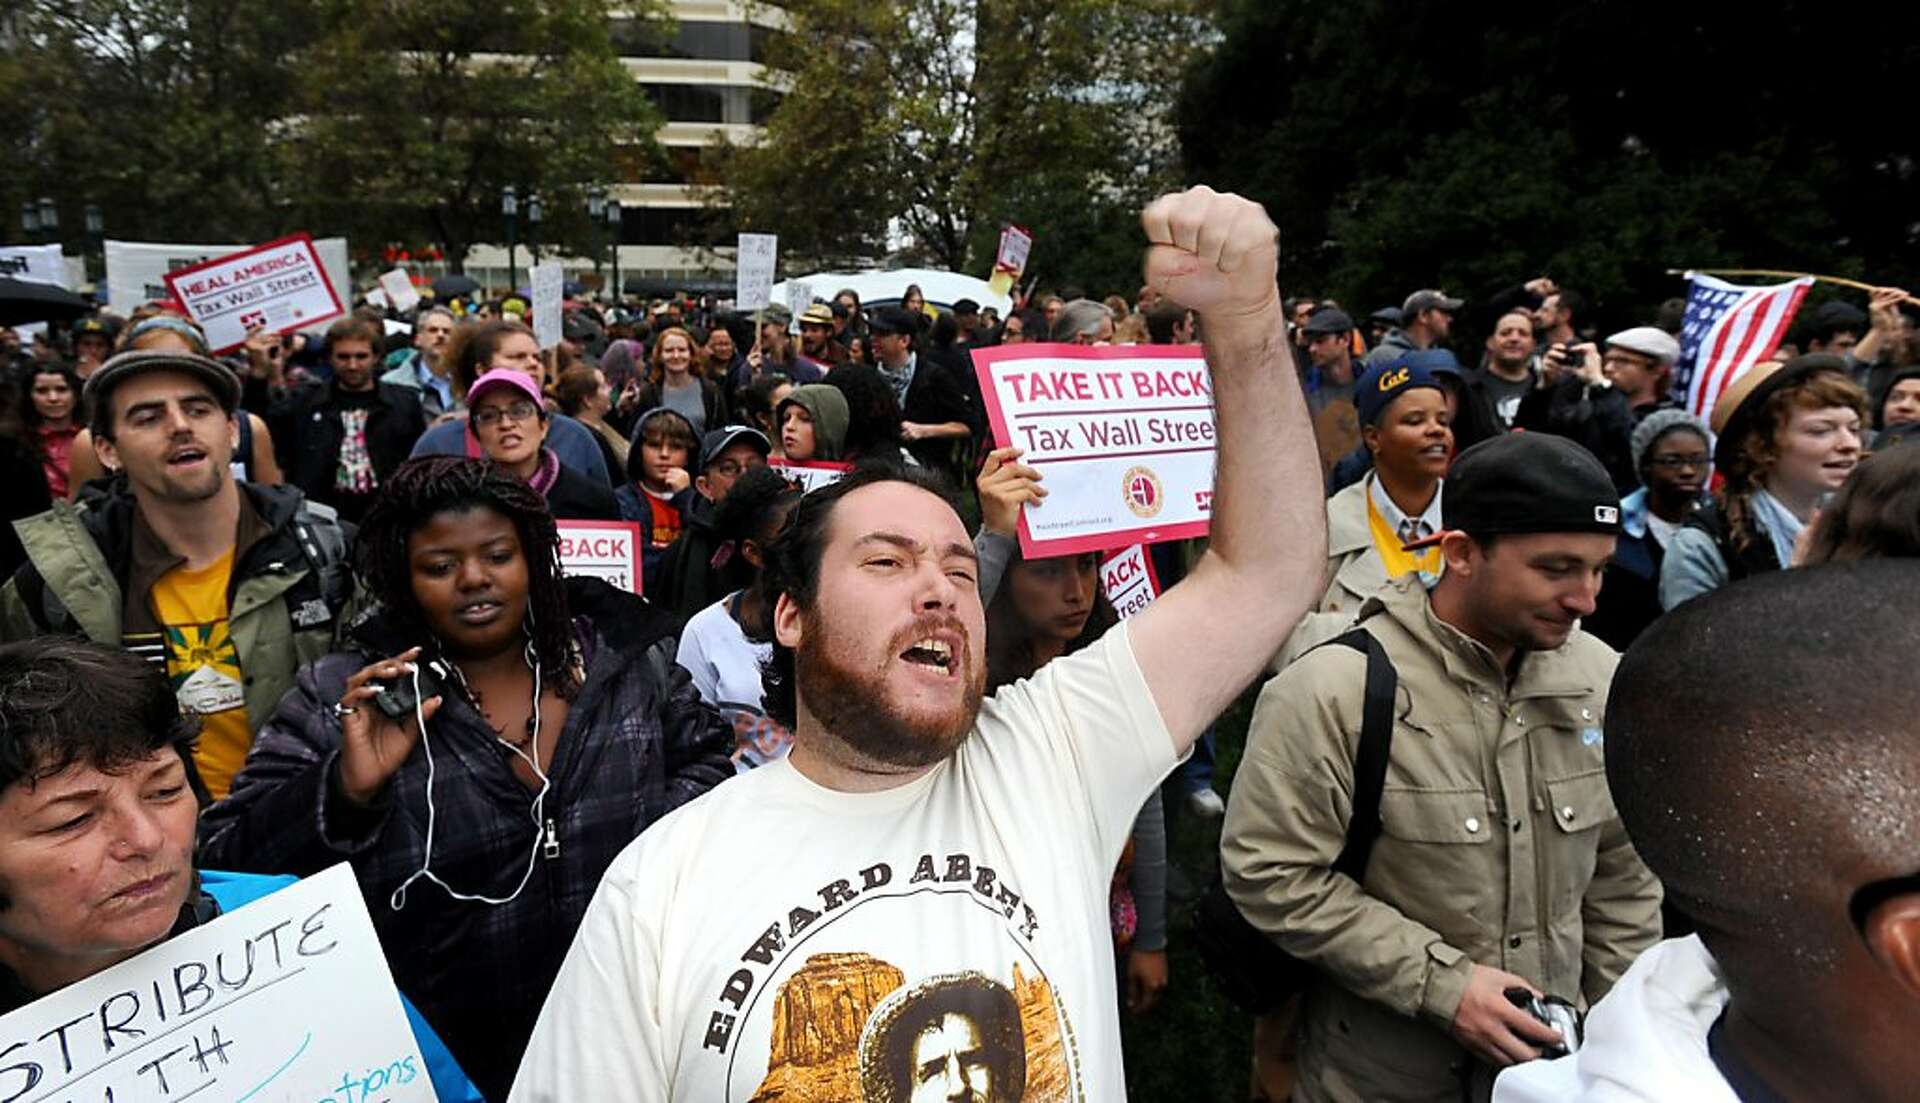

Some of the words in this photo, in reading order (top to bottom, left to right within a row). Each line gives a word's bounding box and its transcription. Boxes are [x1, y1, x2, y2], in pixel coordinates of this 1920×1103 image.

[182, 275, 230, 297] HEAL
[234, 252, 306, 283] AMERICA
[193, 299, 222, 317] Tax
[225, 282, 265, 305] Wall
[266, 270, 316, 294] Street
[1002, 371, 1094, 403] TAKE
[1096, 372, 1125, 400] IT
[1130, 370, 1211, 399] BACK
[1378, 367, 1410, 392] Cal
[1018, 423, 1074, 452] Tax
[1078, 418, 1143, 448] Wall
[559, 538, 626, 558] BACK
[1104, 553, 1142, 594] ACK
[702, 863, 893, 1055] EDWARD
[909, 853, 1040, 942] ABBEY
[0, 902, 339, 1103] STRIBUTE
[319, 1055, 417, 1103] tions
